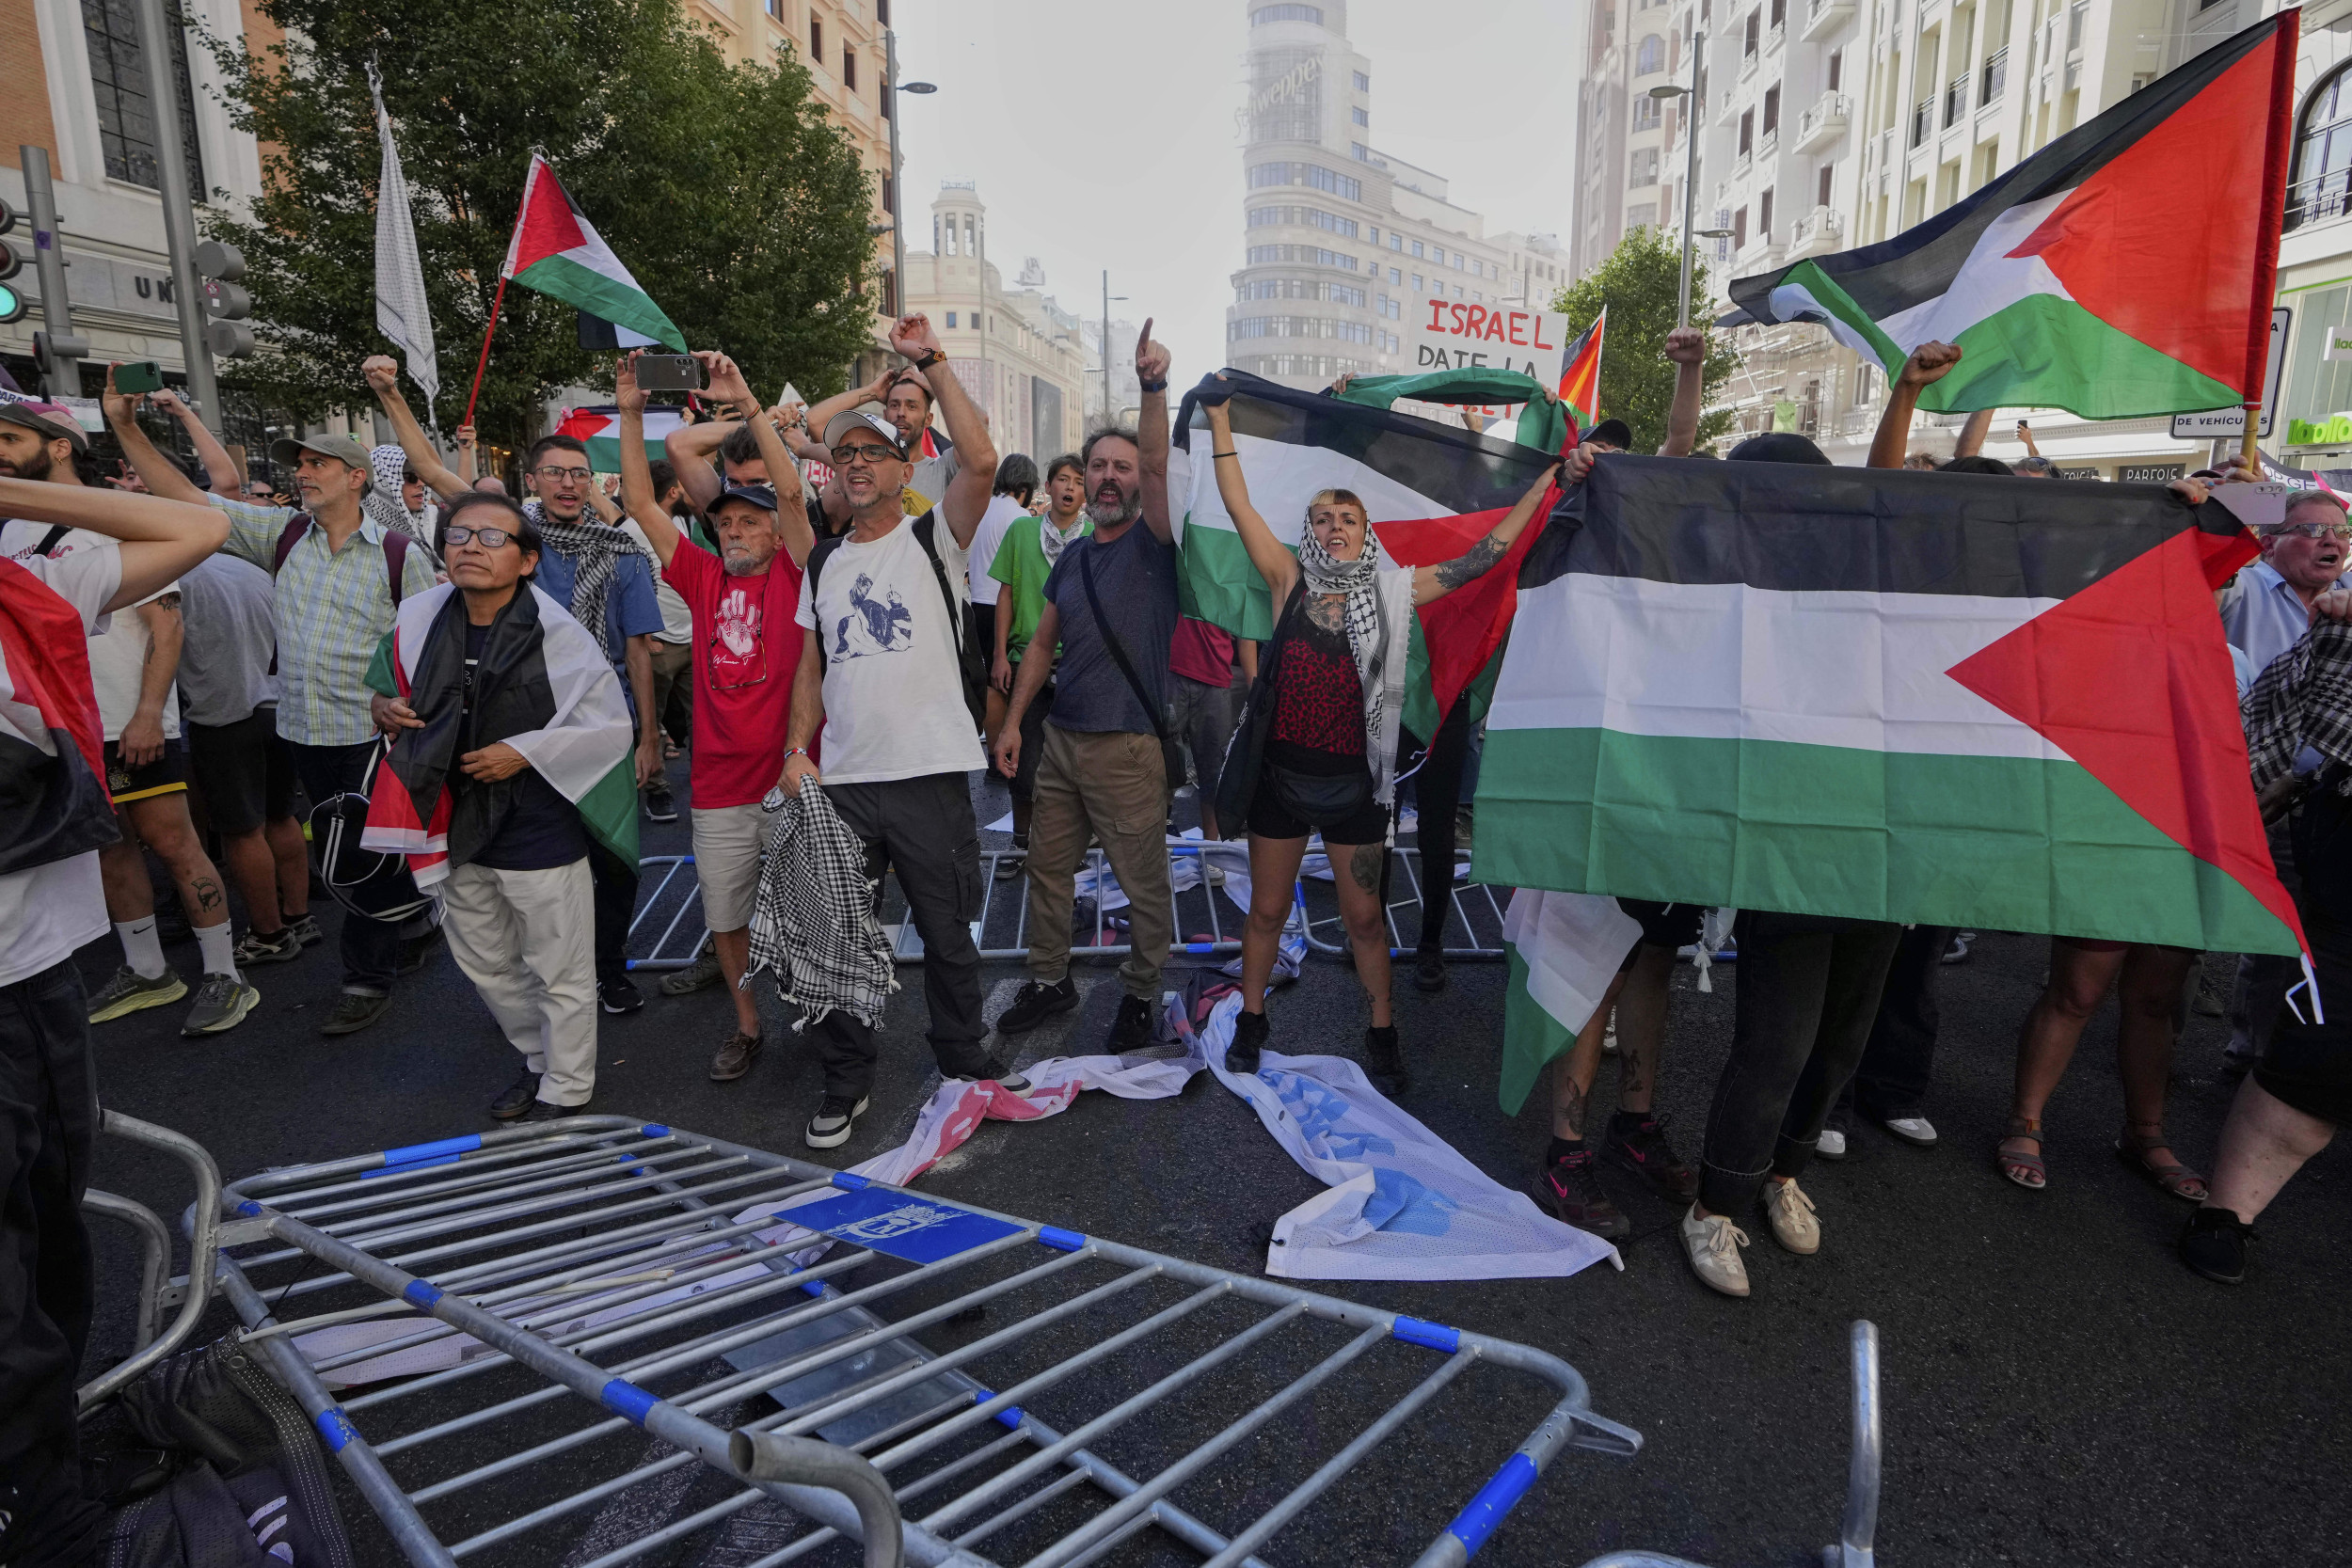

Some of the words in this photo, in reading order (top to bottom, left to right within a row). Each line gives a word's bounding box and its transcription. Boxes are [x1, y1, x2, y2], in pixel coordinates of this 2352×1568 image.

[1426, 299, 1553, 351] ISRAEL
[2177, 418, 2192, 426] DE
[2200, 416, 2268, 425] VEHÍCUS
[2126, 467, 2178, 481] PARFOIS
